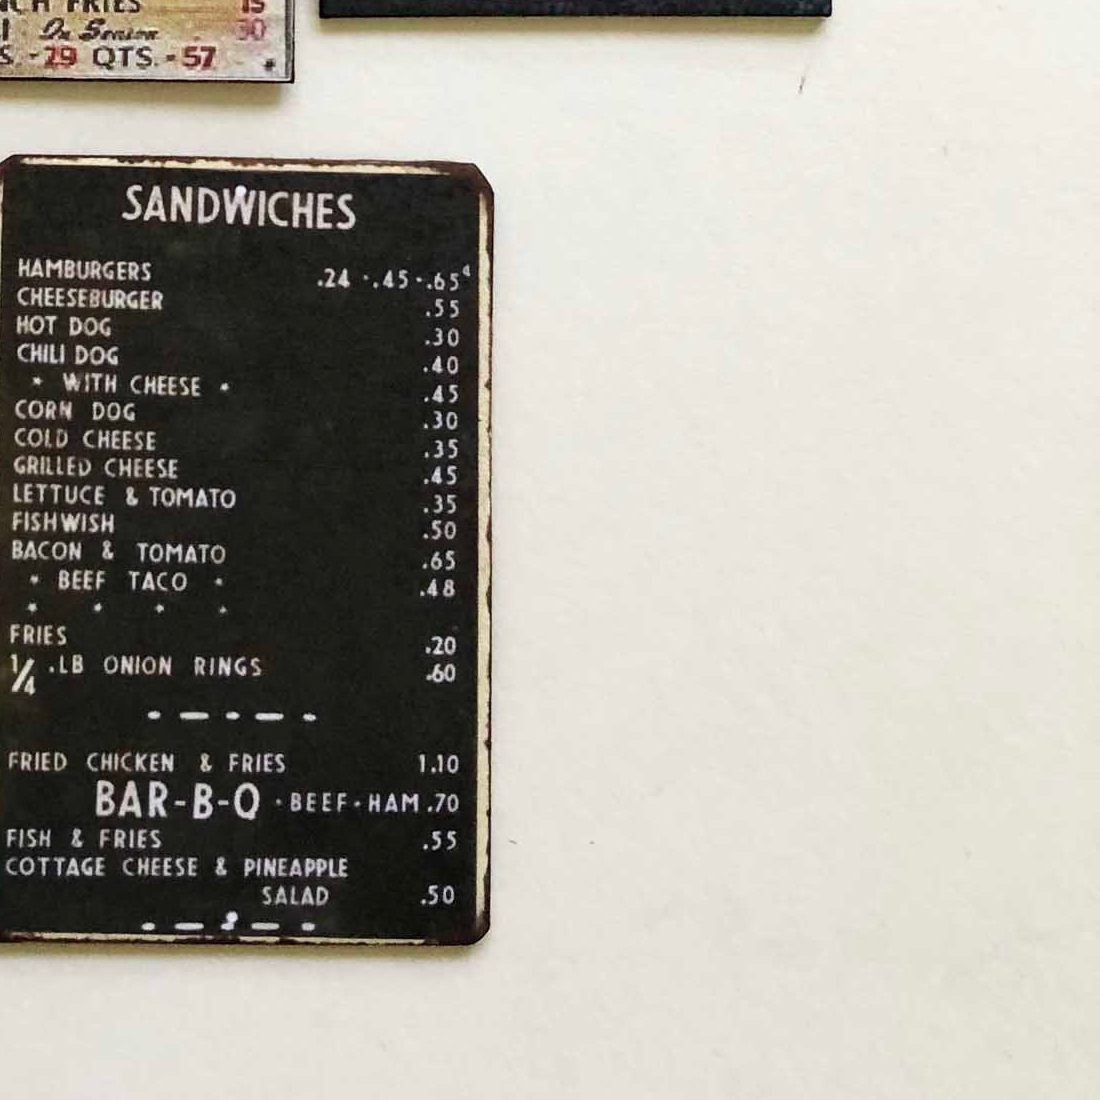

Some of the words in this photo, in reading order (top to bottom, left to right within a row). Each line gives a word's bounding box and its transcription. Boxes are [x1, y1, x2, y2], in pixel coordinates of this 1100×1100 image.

[122, 184, 357, 230] SANDWICHES
[18, 258, 152, 281] HAMBURGERS
[17, 287, 164, 311] CHEESEBURGER
[16, 316, 56, 335] HOT
[69, 316, 112, 336] DOG
[17, 345, 65, 364] CHILI
[75, 345, 118, 365] DOG
[63, 372, 117, 394] WITH
[130, 374, 201, 397] CHEESE
[15, 400, 72, 420] CORN
[93, 402, 136, 422] DOG
[14, 428, 69, 449] COLD
[83, 430, 156, 451] CHEESE
[13, 456, 91, 476] GRILLED
[105, 459, 179, 480] CHEESE
[13, 485, 105, 506] LETTUCE
[149, 487, 236, 509] TOMATO
[12, 513, 114, 533] FISHWISH
[12, 539, 82, 561] BACON
[137, 542, 226, 564] TOMATO
[58, 571, 106, 591] BEEF
[129, 571, 188, 592] TACO
[10, 624, 67, 645] FRIES
[103, 656, 173, 676] ONION
[194, 657, 263, 677] RINGS
[8, 752, 68, 772] FRIED
[87, 753, 175, 773] CHICKEN
[228, 752, 286, 773] FRIES
[95, 780, 260, 821] BAR-B-Q
[291, 792, 348, 813] BEEF
[368, 793, 419, 813] HAM
[7, 829, 51, 849] FISH
[100, 828, 162, 849] FRIES
[6, 856, 106, 877] COTTAGE
[122, 857, 198, 877] CHEESE
[244, 856, 348, 878] PINEAPPLE
[262, 886, 329, 907] SALAD
